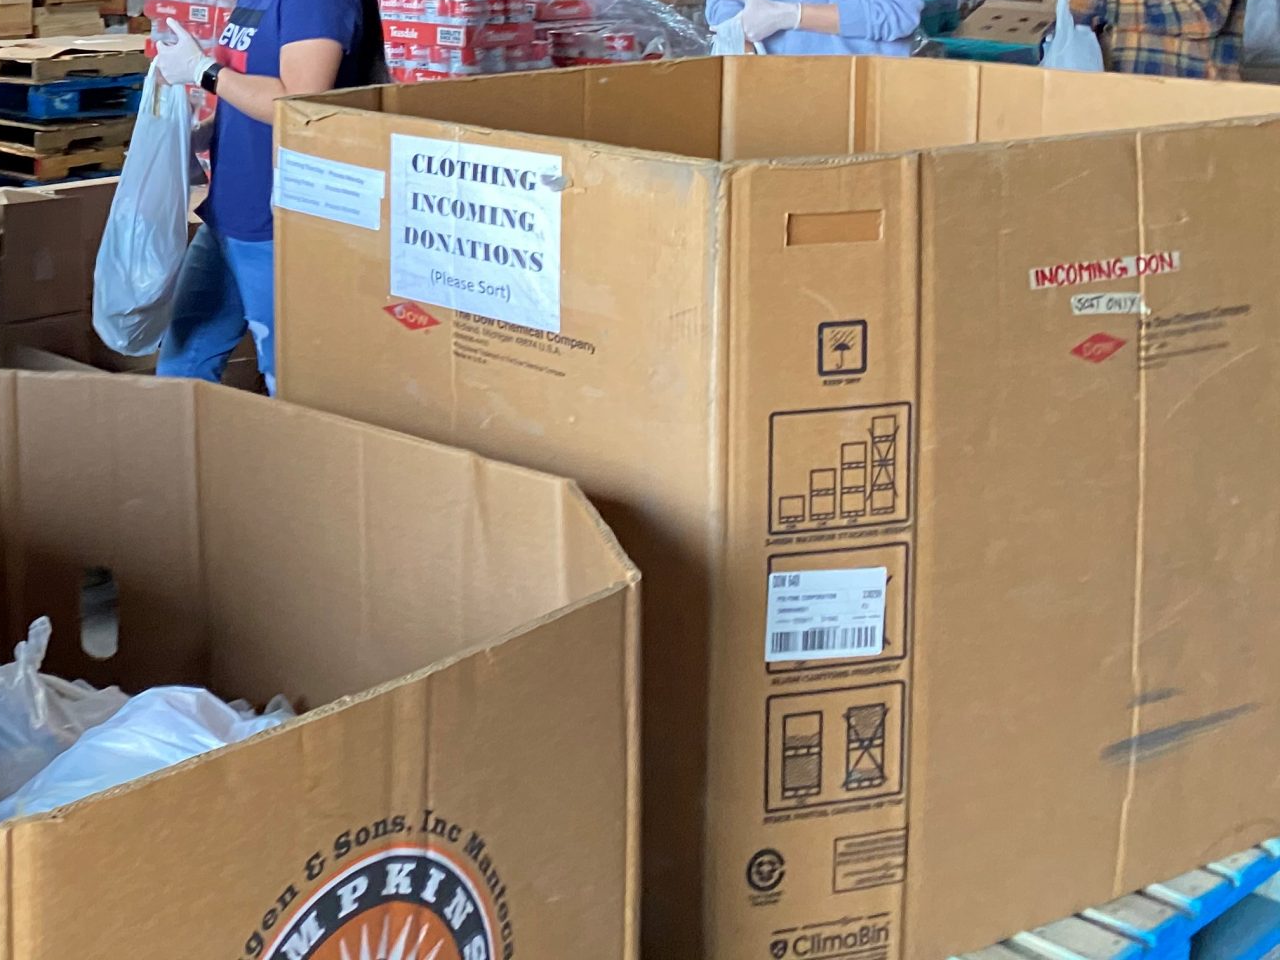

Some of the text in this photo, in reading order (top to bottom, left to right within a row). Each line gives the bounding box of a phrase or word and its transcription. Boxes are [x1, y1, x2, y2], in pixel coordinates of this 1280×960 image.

[411, 153, 537, 191] CLOTHING
[411, 192, 536, 232] INCOMING
[404, 226, 544, 273] DONATIONS
[430, 268, 511, 303] (Please Sort)
[1034, 258, 1128, 287] INCOMING
[497, 320, 544, 340] Chemical
[547, 330, 596, 355] Company
[245, 884, 299, 960] gen
[303, 850, 327, 881] &
[421, 809, 463, 843] Inc
[280, 861, 488, 960] MPKINS
[792, 924, 890, 957] ClimaBin
